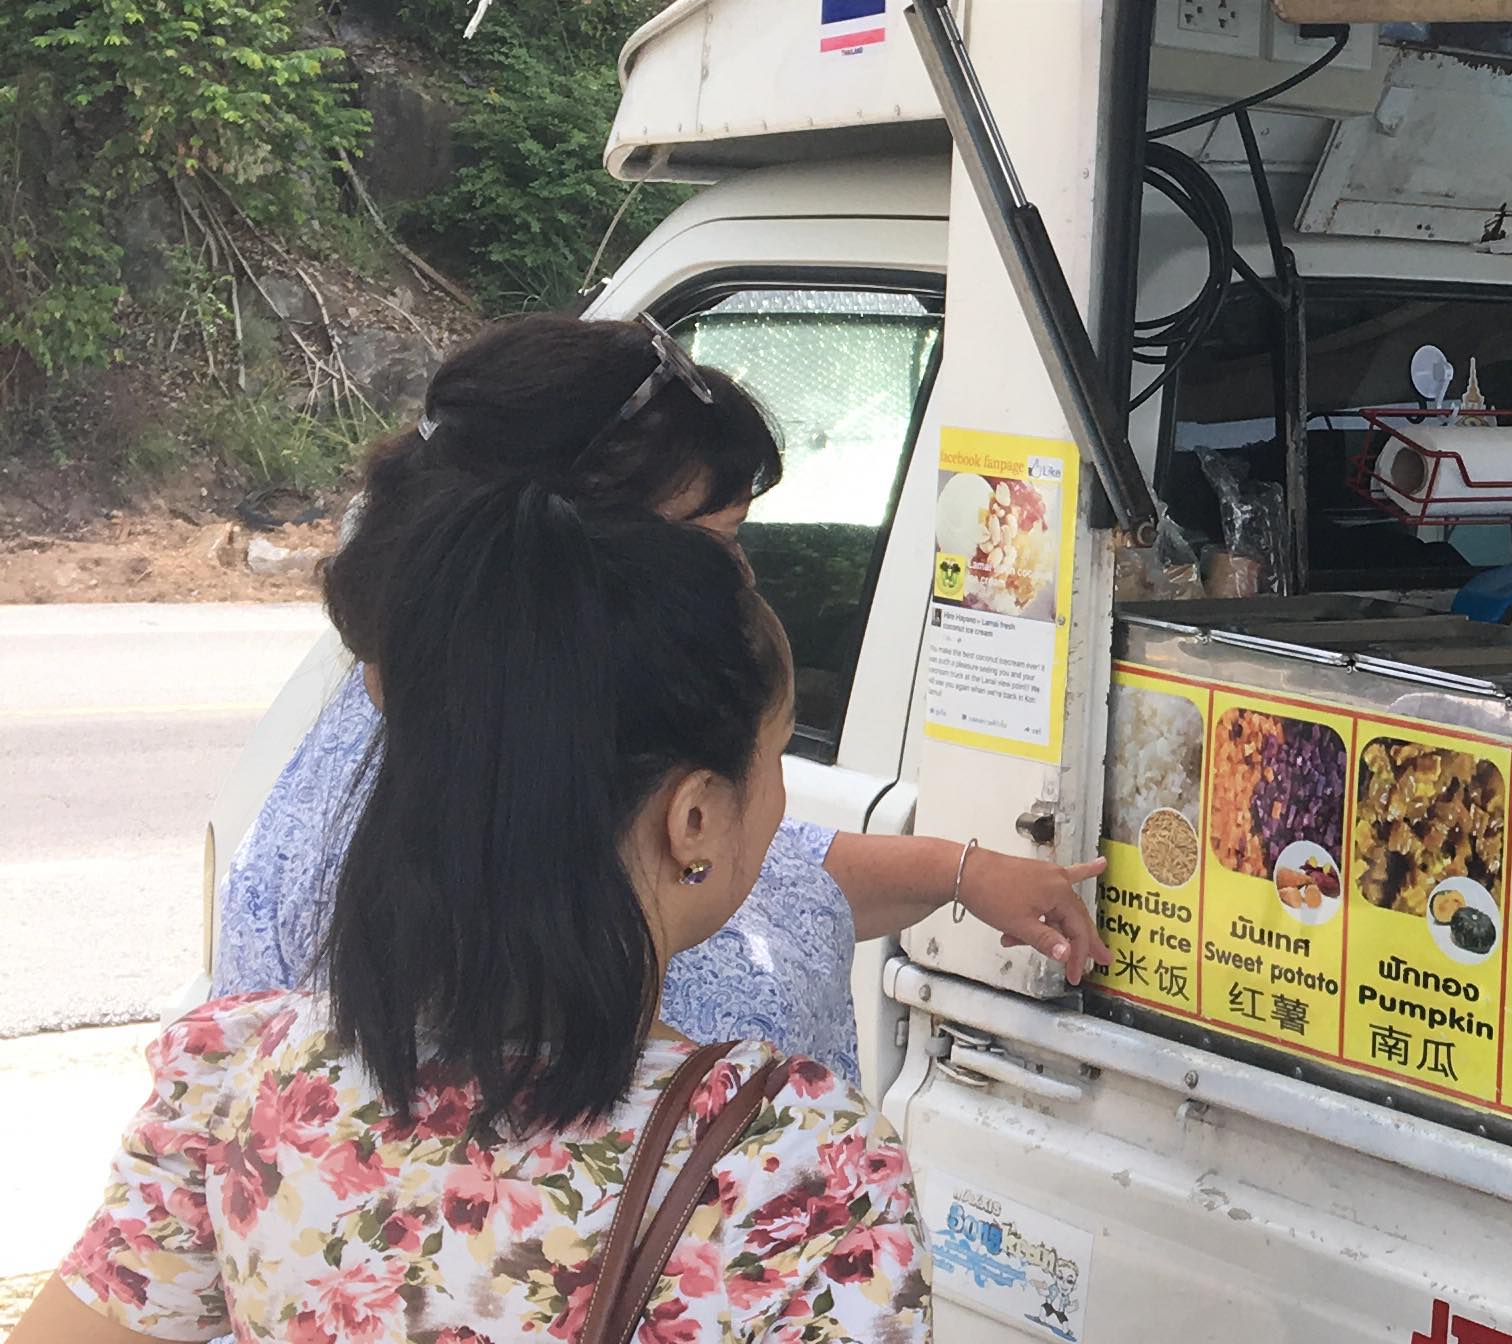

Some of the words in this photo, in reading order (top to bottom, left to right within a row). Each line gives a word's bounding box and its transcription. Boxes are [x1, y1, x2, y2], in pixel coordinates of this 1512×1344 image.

[1099, 909, 1141, 943] icky
[1149, 926, 1192, 954] rice
[1230, 915, 1311, 958] มันเทศ
[1093, 945, 1190, 1002] 米饭
[1204, 940, 1263, 974] Sweet
[1270, 963, 1339, 995] potato
[1379, 955, 1480, 1002] ฟักทอง
[1228, 981, 1311, 1036] 红薯
[1358, 984, 1494, 1041] Pumpkin
[1368, 1023, 1459, 1082] 南瓜
